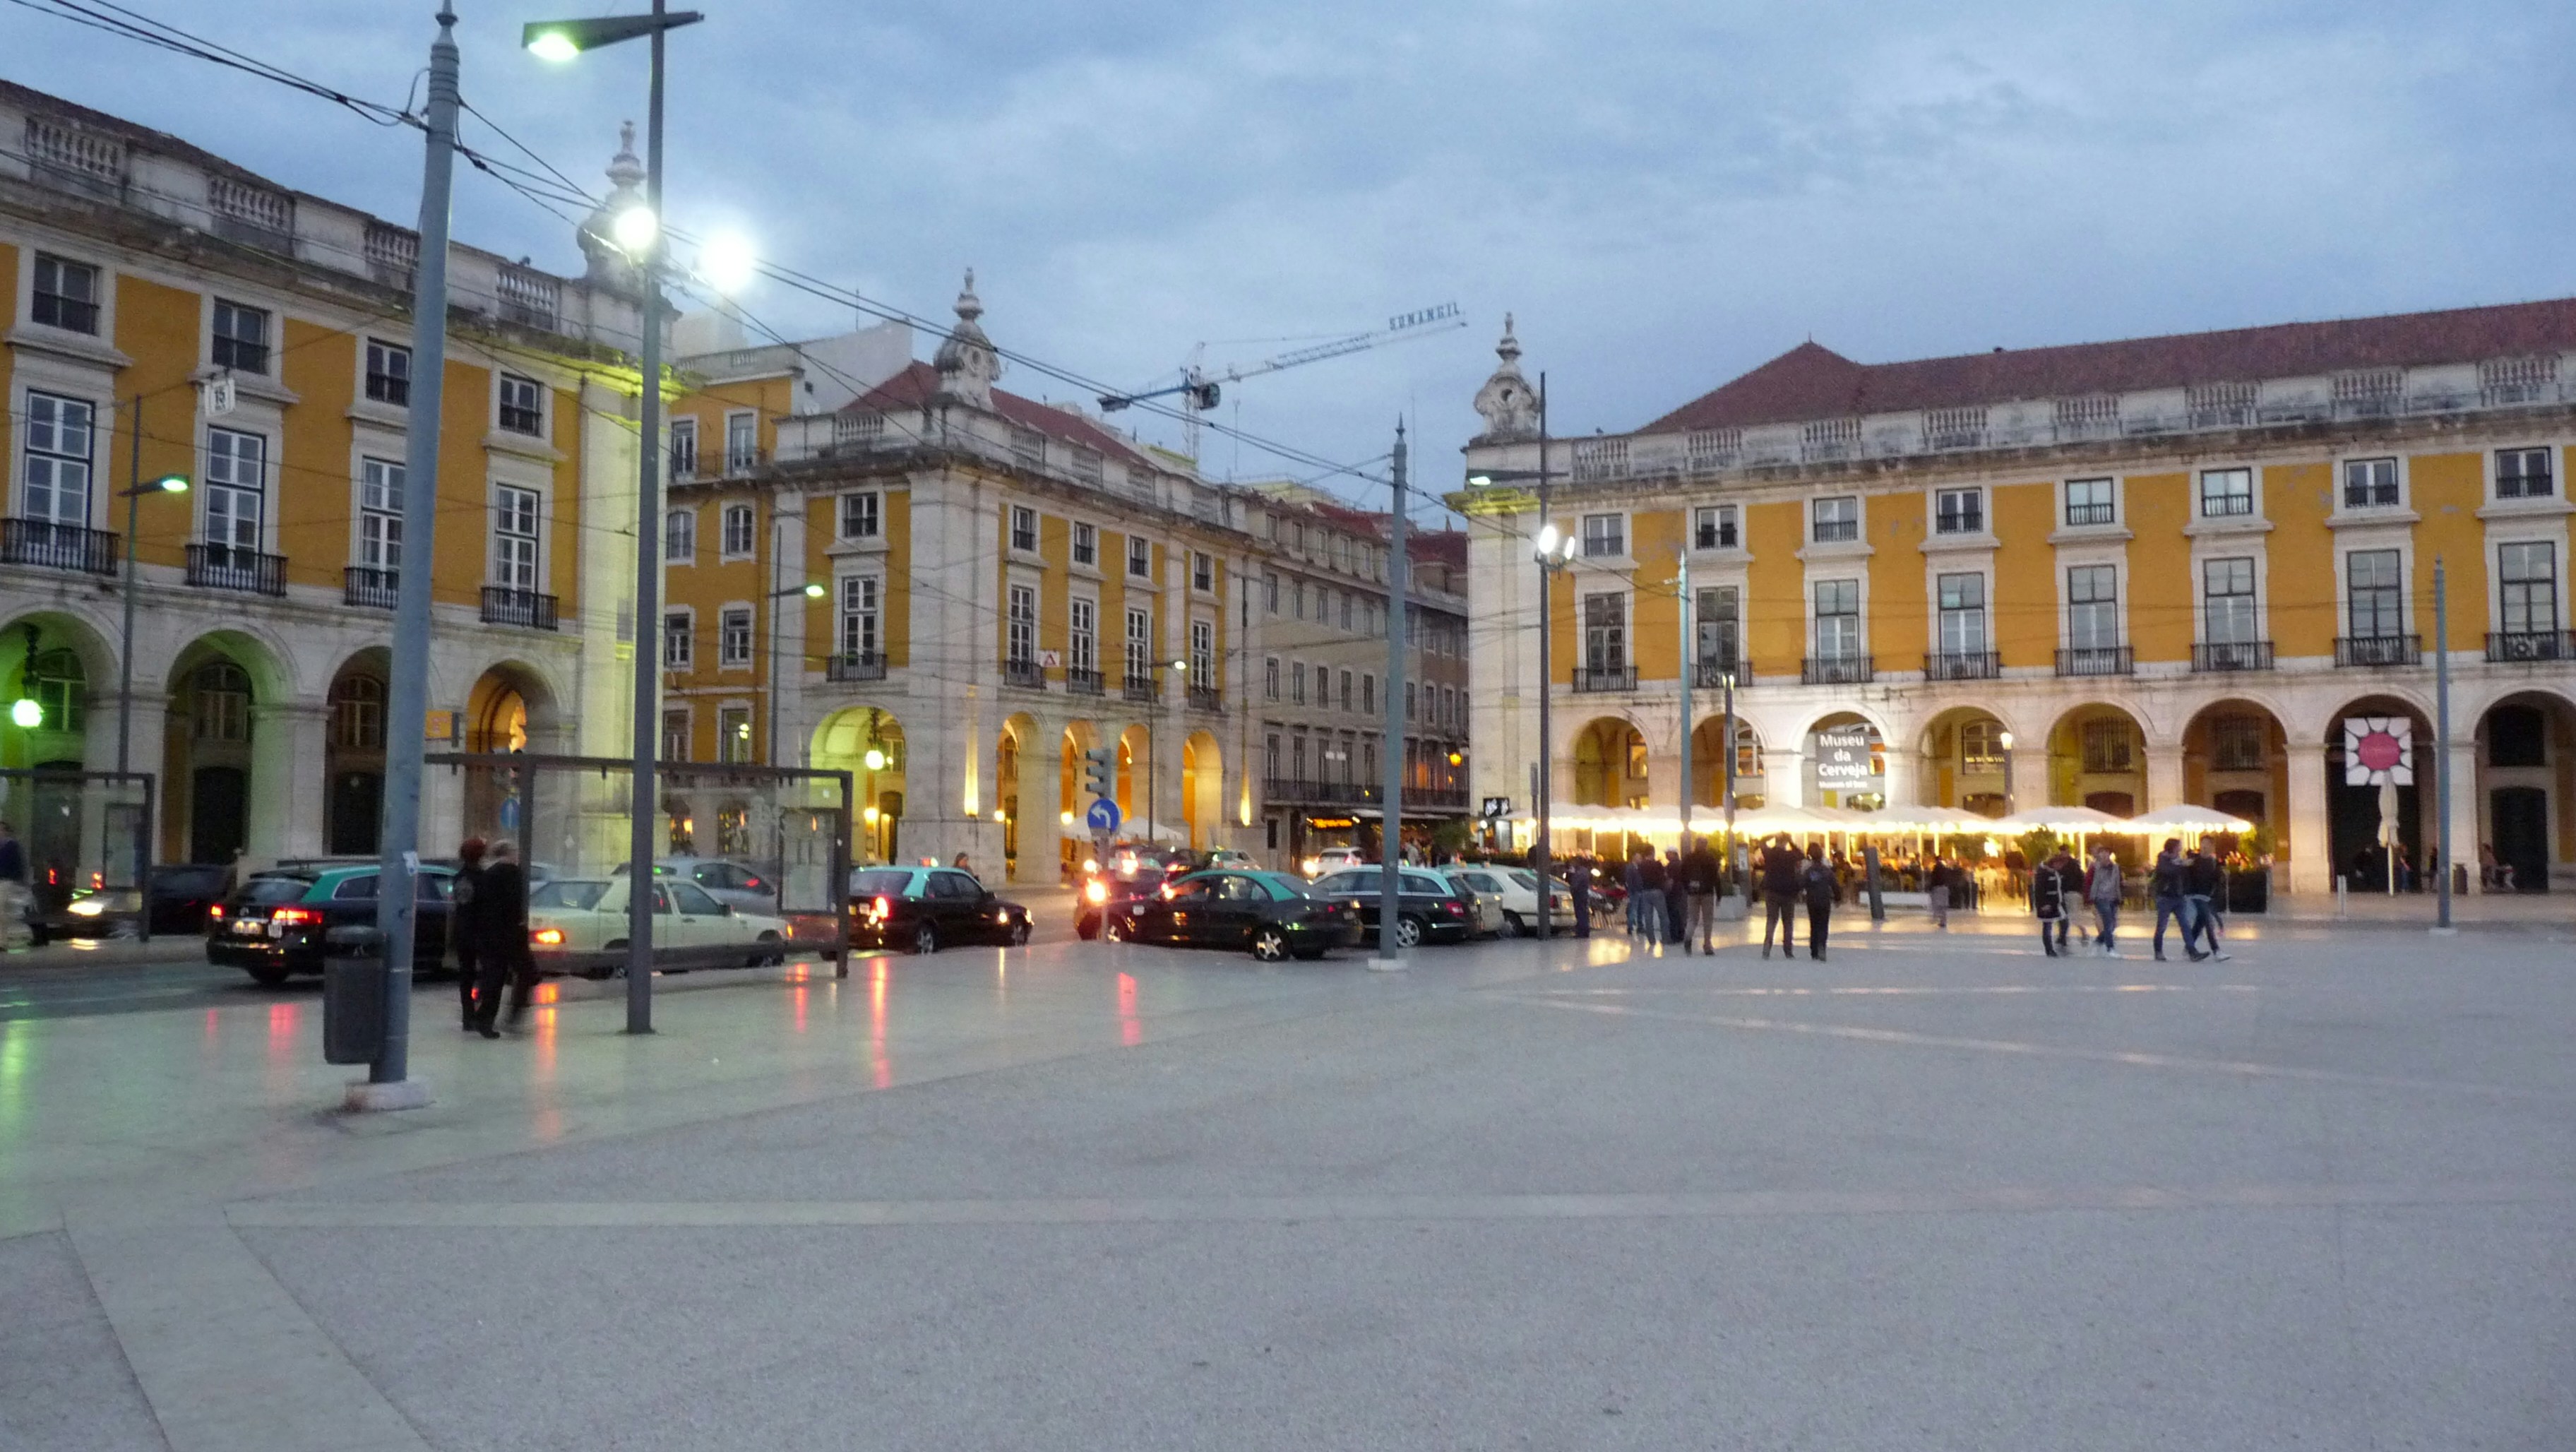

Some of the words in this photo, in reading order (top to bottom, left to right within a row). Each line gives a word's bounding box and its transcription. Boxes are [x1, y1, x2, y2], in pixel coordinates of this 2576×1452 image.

[1820, 734, 1864, 747] Museu
[1834, 748, 1851, 761] da
[1819, 762, 1868, 778] Cerveja
